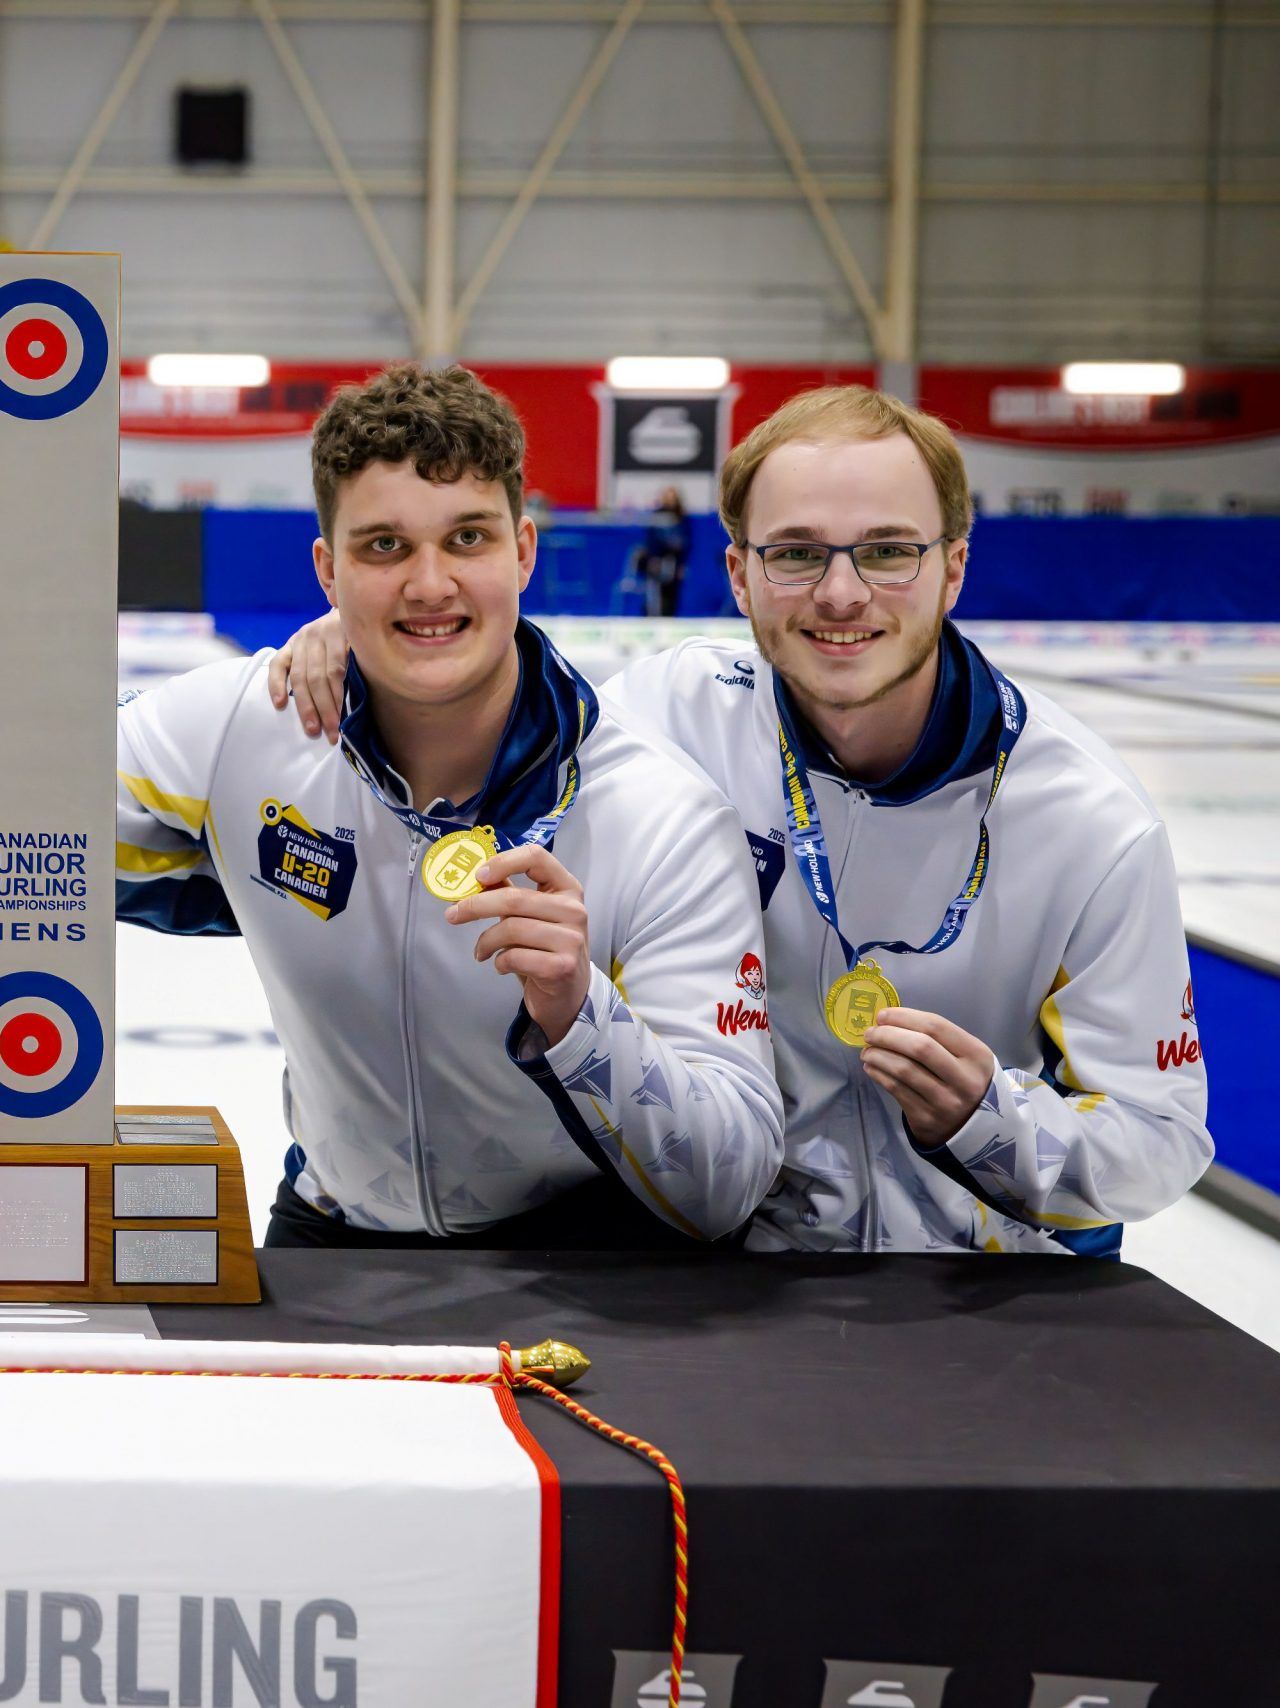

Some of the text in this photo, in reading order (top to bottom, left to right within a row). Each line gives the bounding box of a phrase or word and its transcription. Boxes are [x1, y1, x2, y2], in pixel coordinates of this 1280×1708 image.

[784, 751, 797, 777] U-20
[789, 775, 811, 830] CANADIAN
[288, 831, 335, 856] NEW HOLLAND
[334, 826, 356, 841] 2025
[282, 852, 331, 887] U-20
[285, 841, 339, 873] CANADIAN
[804, 839, 825, 891] NEW HOLLAND
[964, 840, 987, 900] CANADIAN
[274, 867, 328, 899] CANADIEN
[938, 906, 962, 947] HOLLAND
